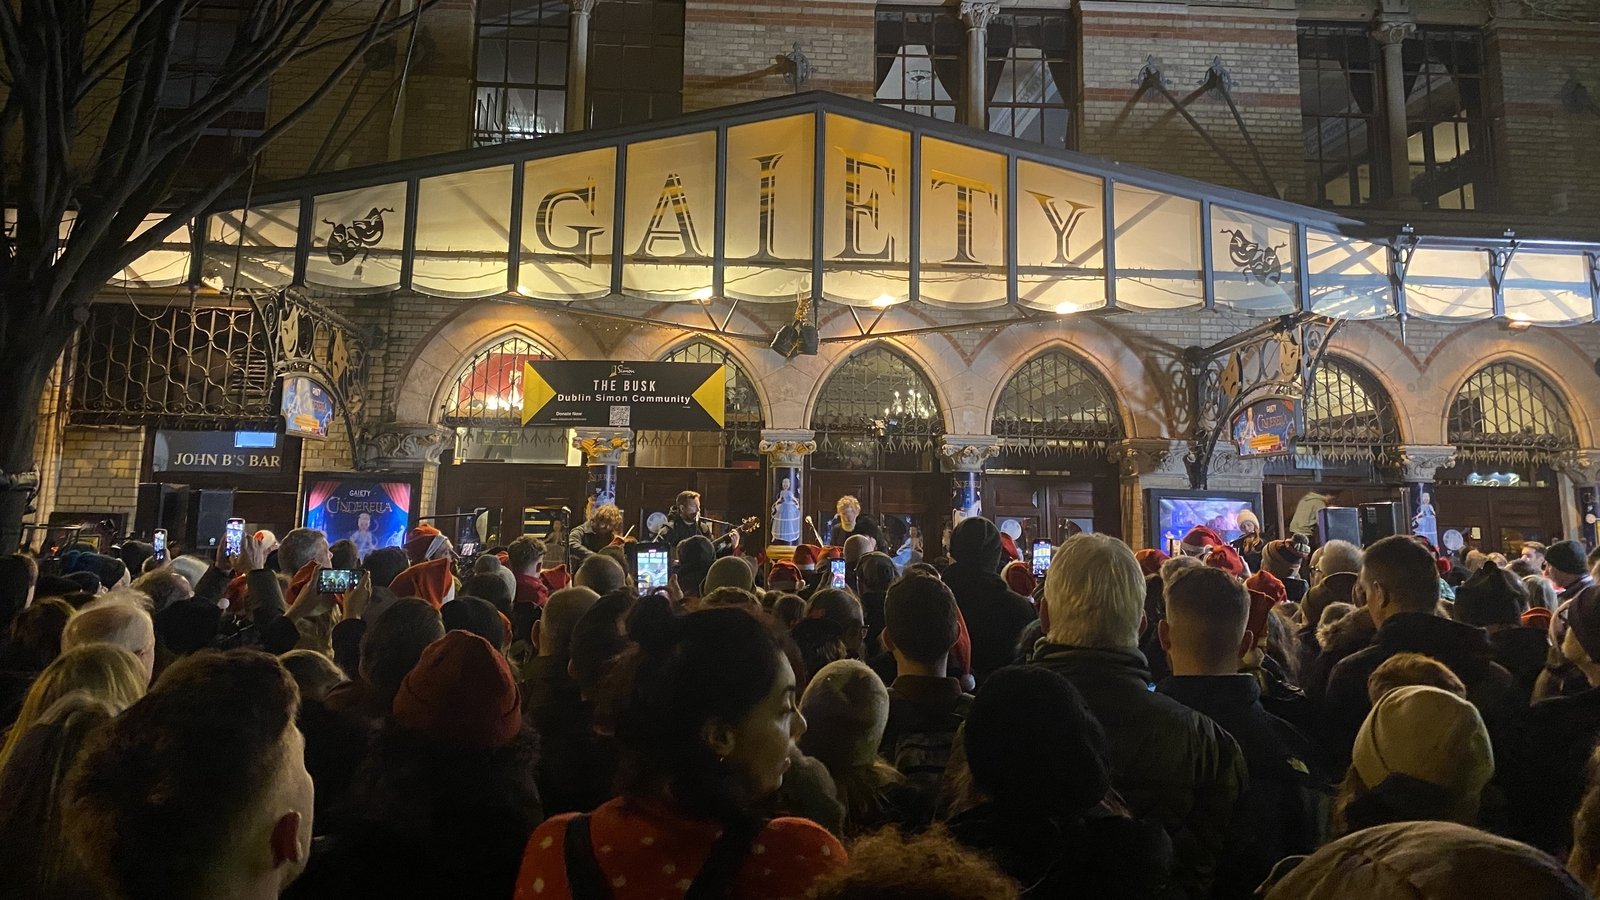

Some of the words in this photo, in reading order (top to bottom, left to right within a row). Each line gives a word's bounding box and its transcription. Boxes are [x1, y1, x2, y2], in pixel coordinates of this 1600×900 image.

[534, 146, 1096, 268] GAIETY
[593, 380, 617, 392] THE
[623, 380, 657, 392] BUSK
[557, 394, 592, 402] Dublin
[595, 394, 628, 402] Simon
[631, 394, 691, 405] Community
[174, 453, 219, 466] JOHN
[222, 454, 245, 466] B'S
[248, 455, 281, 467] BAR
[349, 489, 371, 498] GAIETY
[326, 496, 393, 514] CINDERELLA
